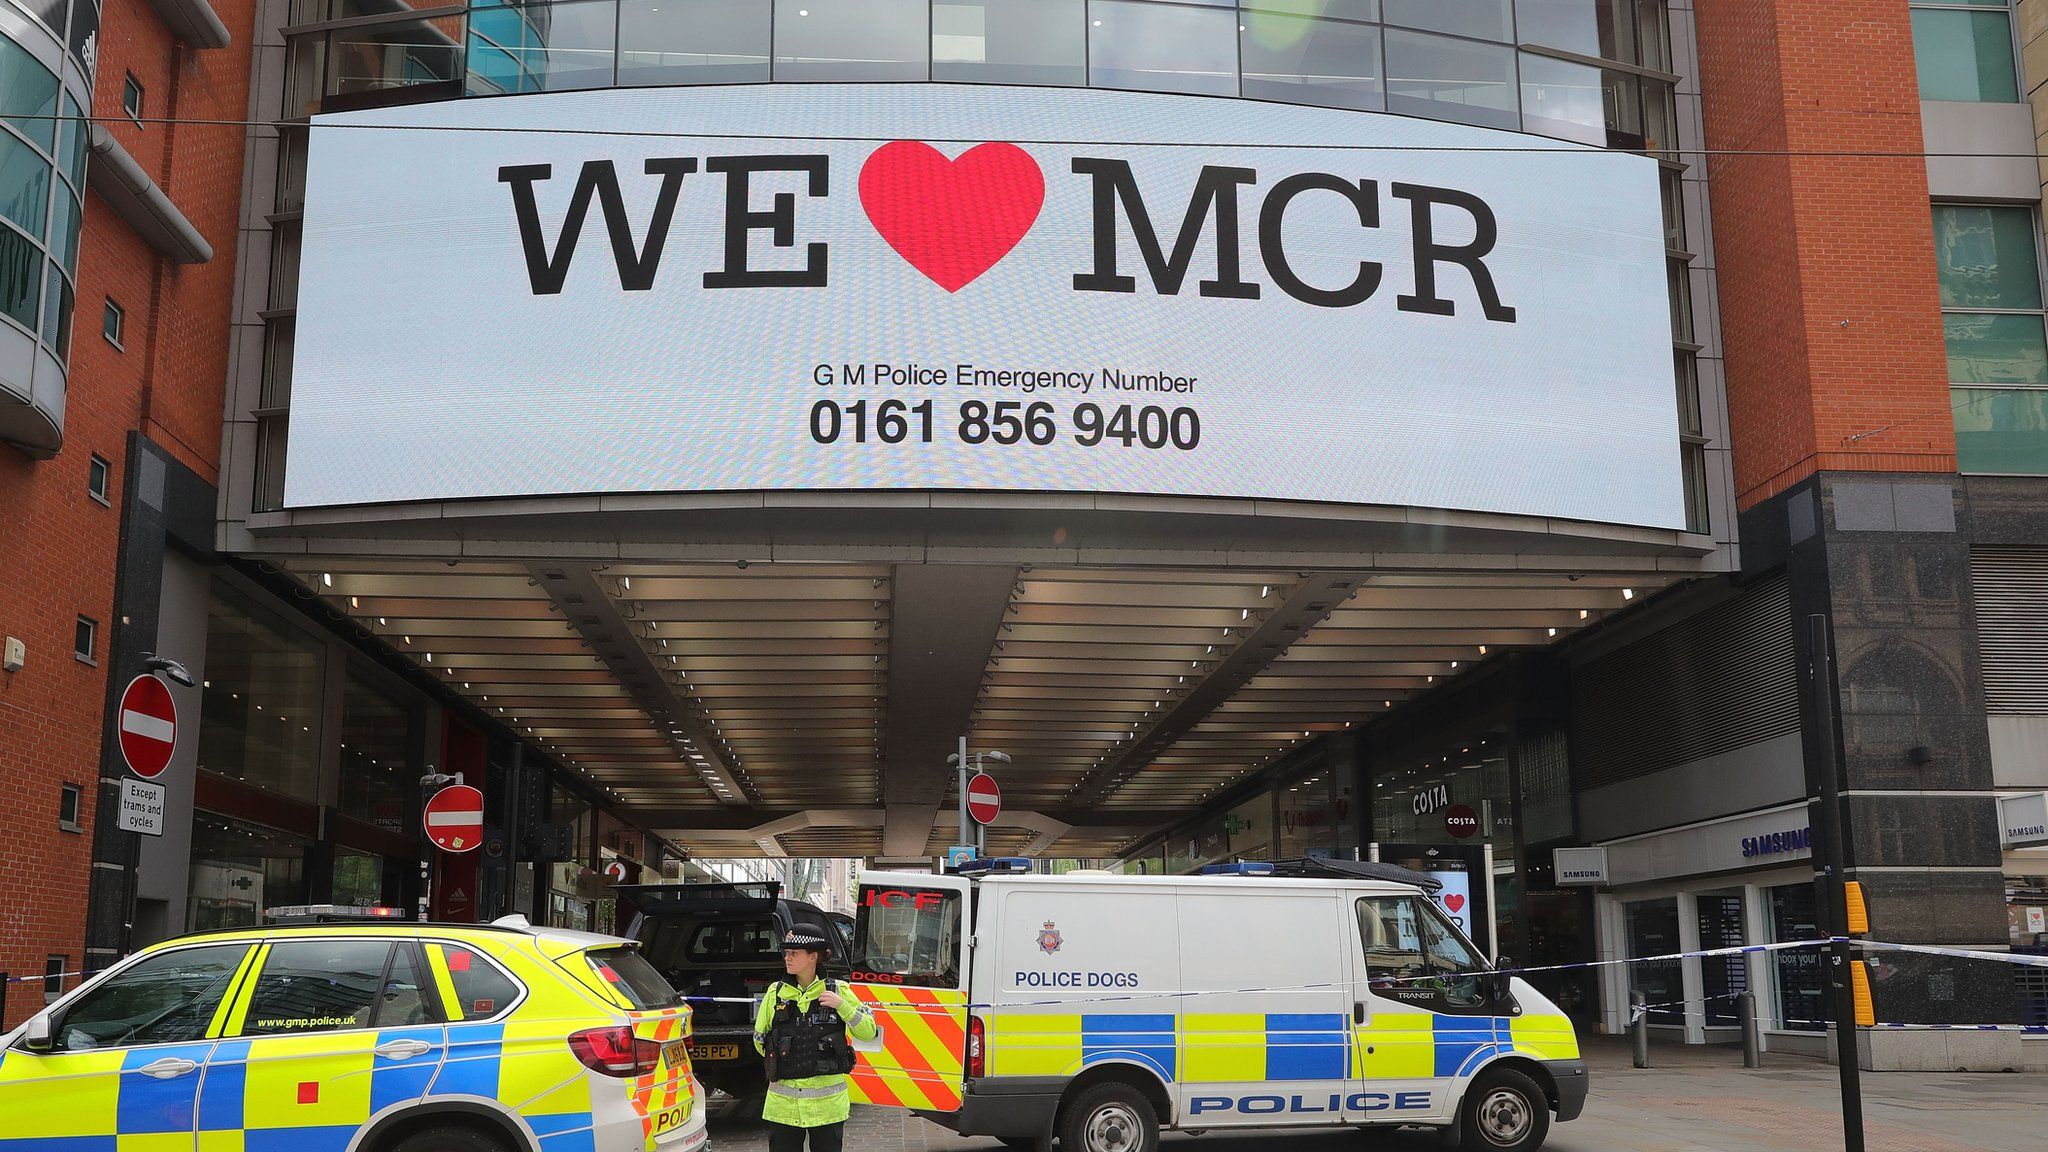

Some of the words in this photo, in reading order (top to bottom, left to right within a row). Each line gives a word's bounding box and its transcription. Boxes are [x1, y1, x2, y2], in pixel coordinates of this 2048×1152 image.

[497, 154, 829, 296] WE
[1071, 156, 1517, 324] MCR
[813, 364, 834, 386] G
[843, 364, 865, 386] M
[874, 363, 948, 386] Police
[956, 364, 1094, 394] Emergency
[1103, 368, 1198, 393] Number
[809, 398, 933, 445] 0161
[958, 399, 1056, 446] 856
[1072, 402, 1201, 451] 9400
[131, 785, 157, 801] Except
[1413, 784, 1448, 815] COSTA
[123, 798, 146, 813] trams
[147, 805, 162, 815] and
[129, 816, 154, 828] cycles
[1447, 817, 1476, 826] COSTA
[2008, 825, 2045, 837] SAMSUNG
[1563, 870, 1600, 879] SAMSUNG
[850, 970, 904, 984] DOGS
[1015, 971, 1082, 987] POLICE
[1087, 972, 1139, 987] DOGS
[257, 1015, 357, 1029] www.gmp.police.uk
[711, 1046, 734, 1058] PCY
[1189, 1091, 1432, 1115] POLICE
